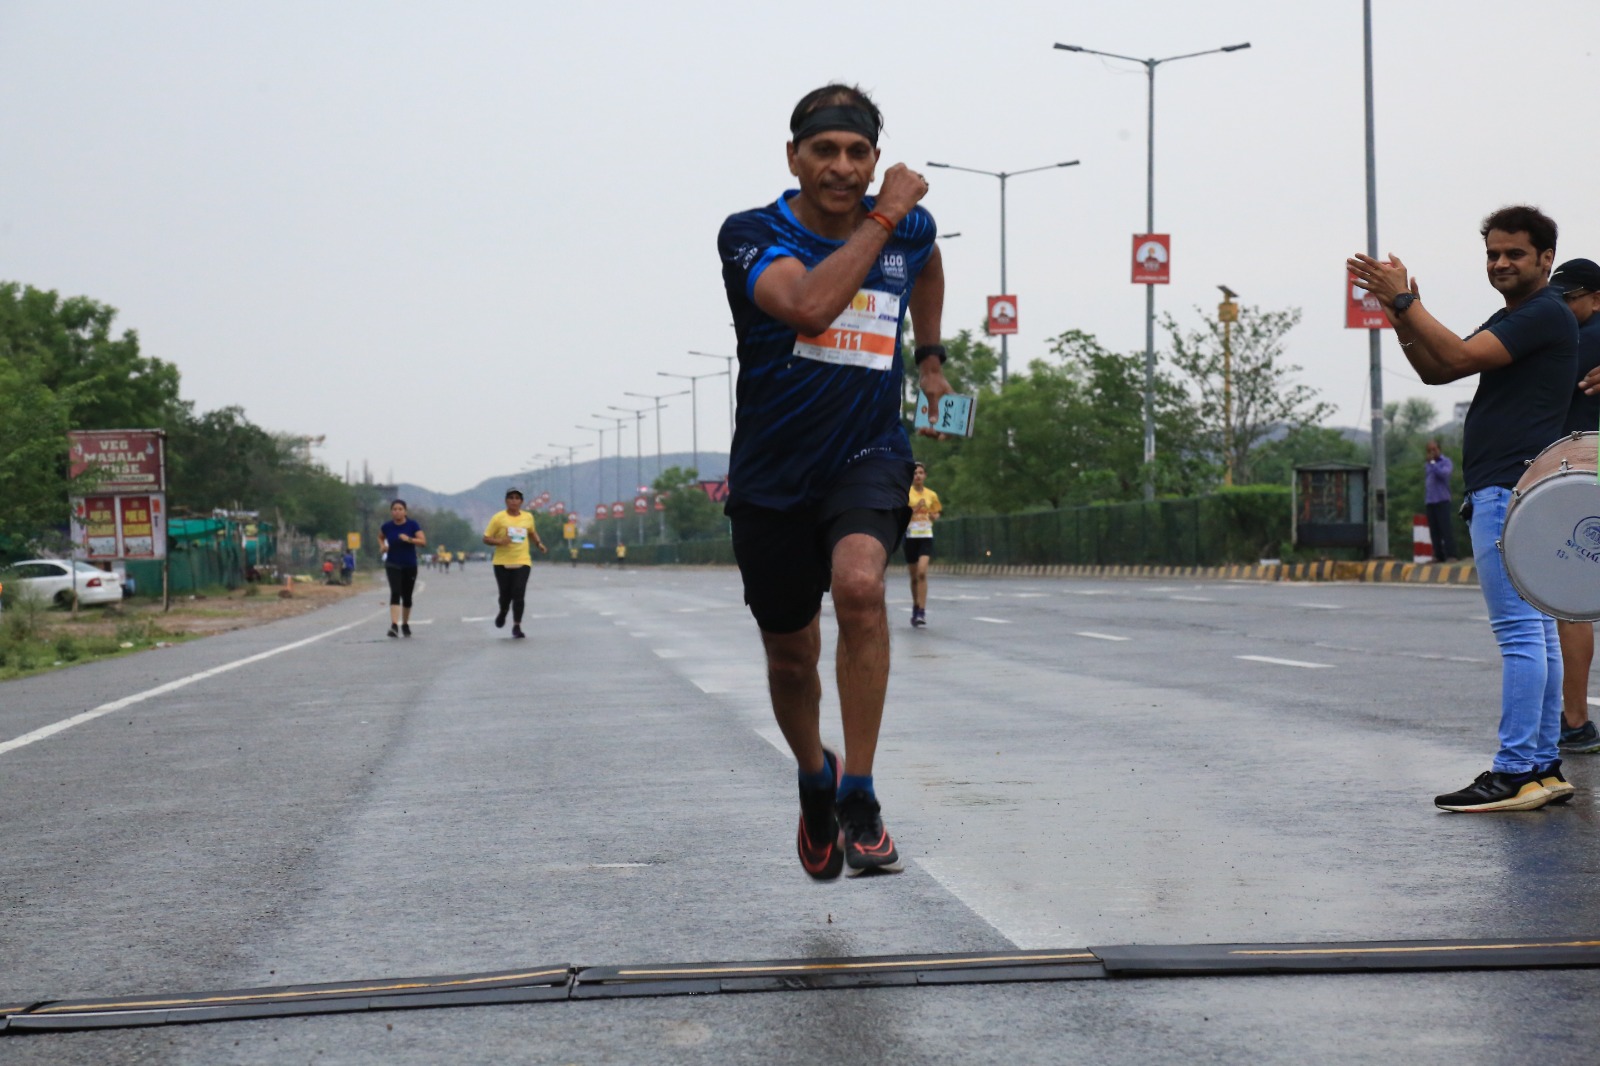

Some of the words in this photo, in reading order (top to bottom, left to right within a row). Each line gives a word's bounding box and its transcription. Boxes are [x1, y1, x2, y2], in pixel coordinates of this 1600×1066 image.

[884, 254, 903, 267] 100
[834, 331, 863, 351] 111
[99, 440, 128, 450] VEG
[83, 451, 146, 462] MASALA
[1566, 539, 1599, 564] SPECIAL
